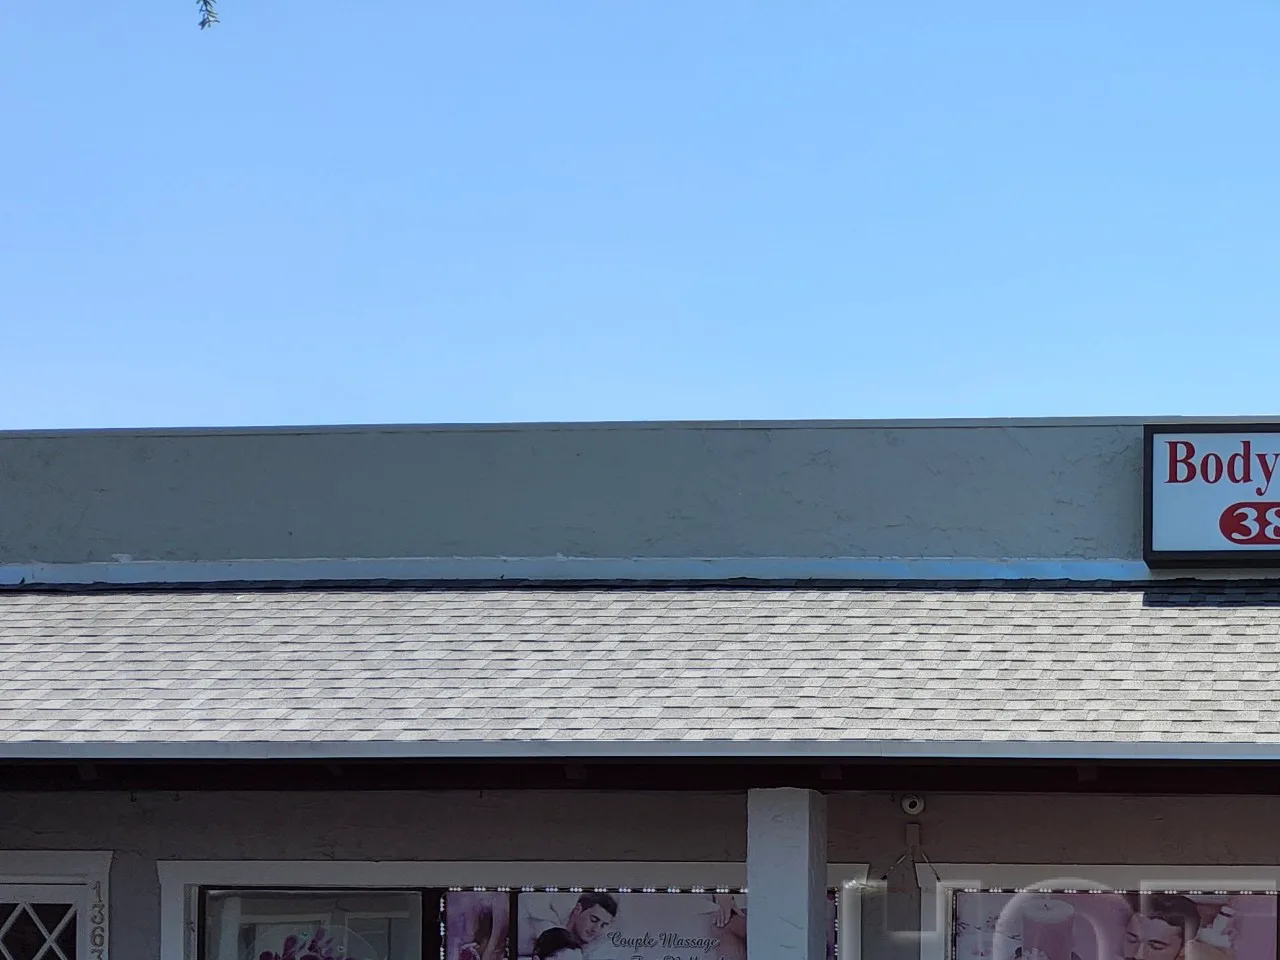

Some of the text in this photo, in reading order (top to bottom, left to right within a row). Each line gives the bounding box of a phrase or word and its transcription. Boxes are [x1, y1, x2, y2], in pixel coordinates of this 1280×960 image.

[1164, 439, 1280, 496] Body
[607, 932, 720, 953] Couple Massage
